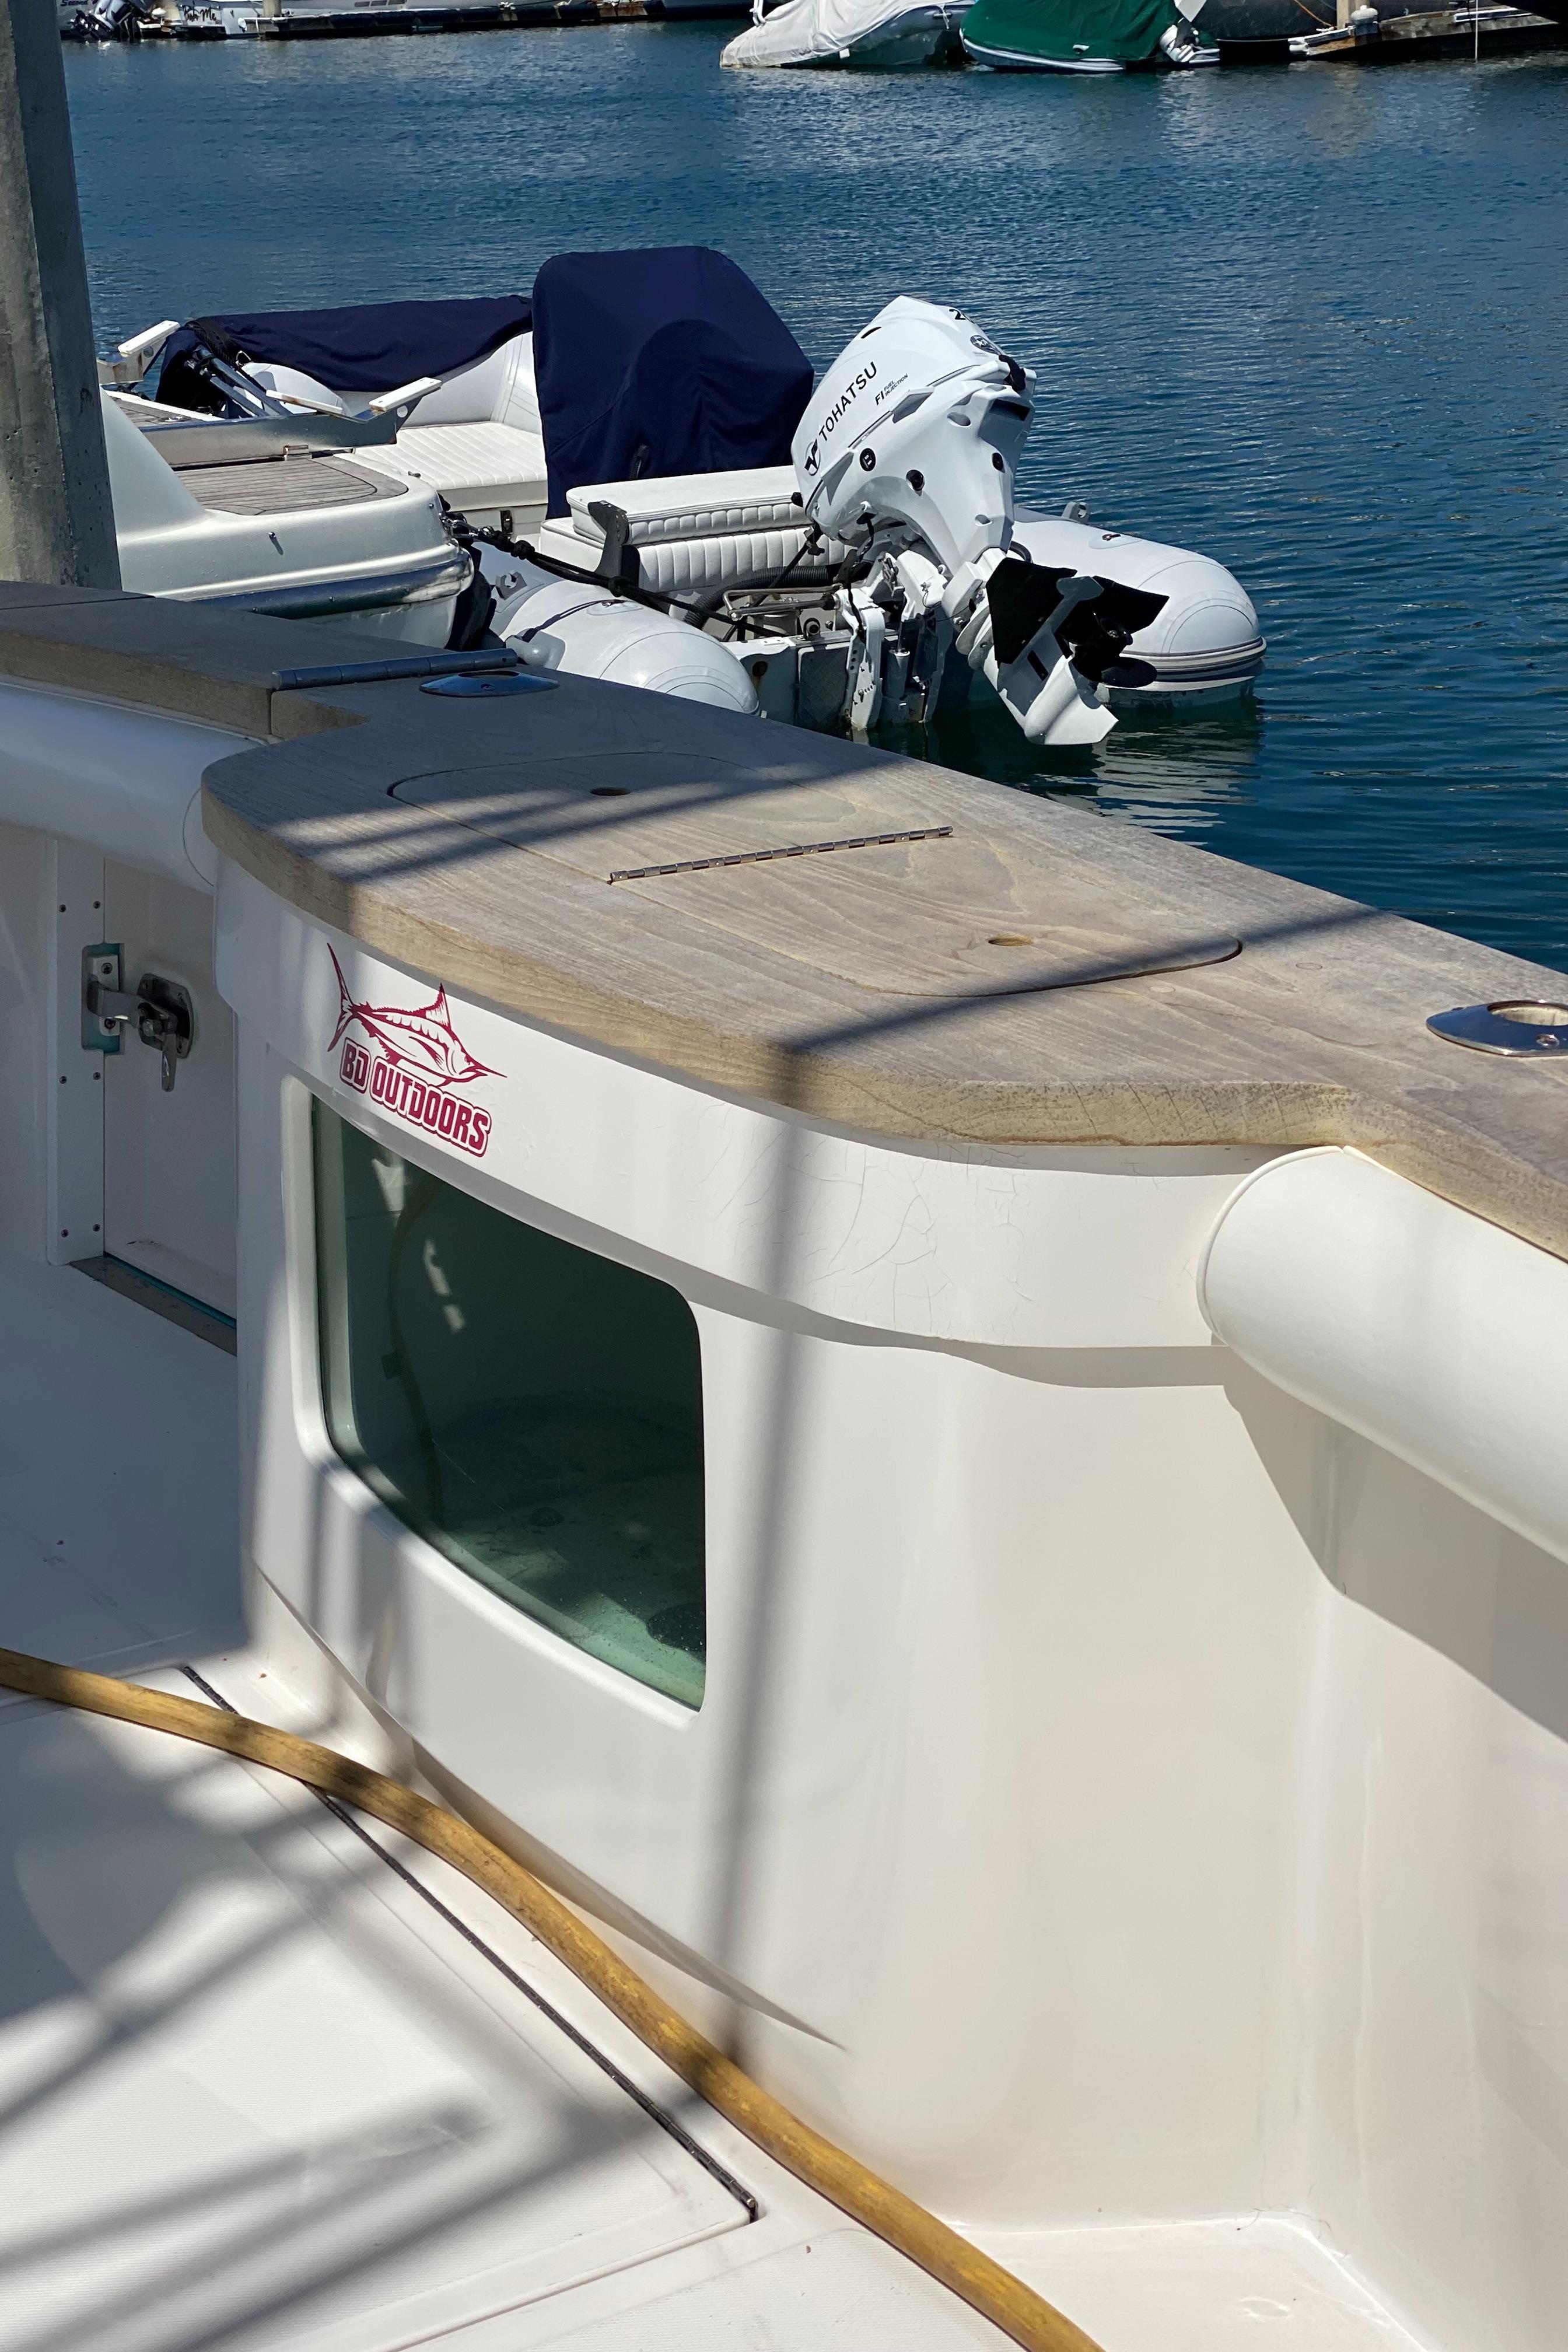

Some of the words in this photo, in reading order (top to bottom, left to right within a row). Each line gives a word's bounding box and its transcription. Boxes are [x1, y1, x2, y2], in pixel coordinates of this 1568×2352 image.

[884, 380, 894, 391] FUEL
[885, 373, 908, 396] INJECTION
[818, 361, 877, 442] TOHATSU
[874, 390, 884, 405] FI
[341, 1040, 370, 1090] BD
[371, 1060, 490, 1153] OUTDOORS
